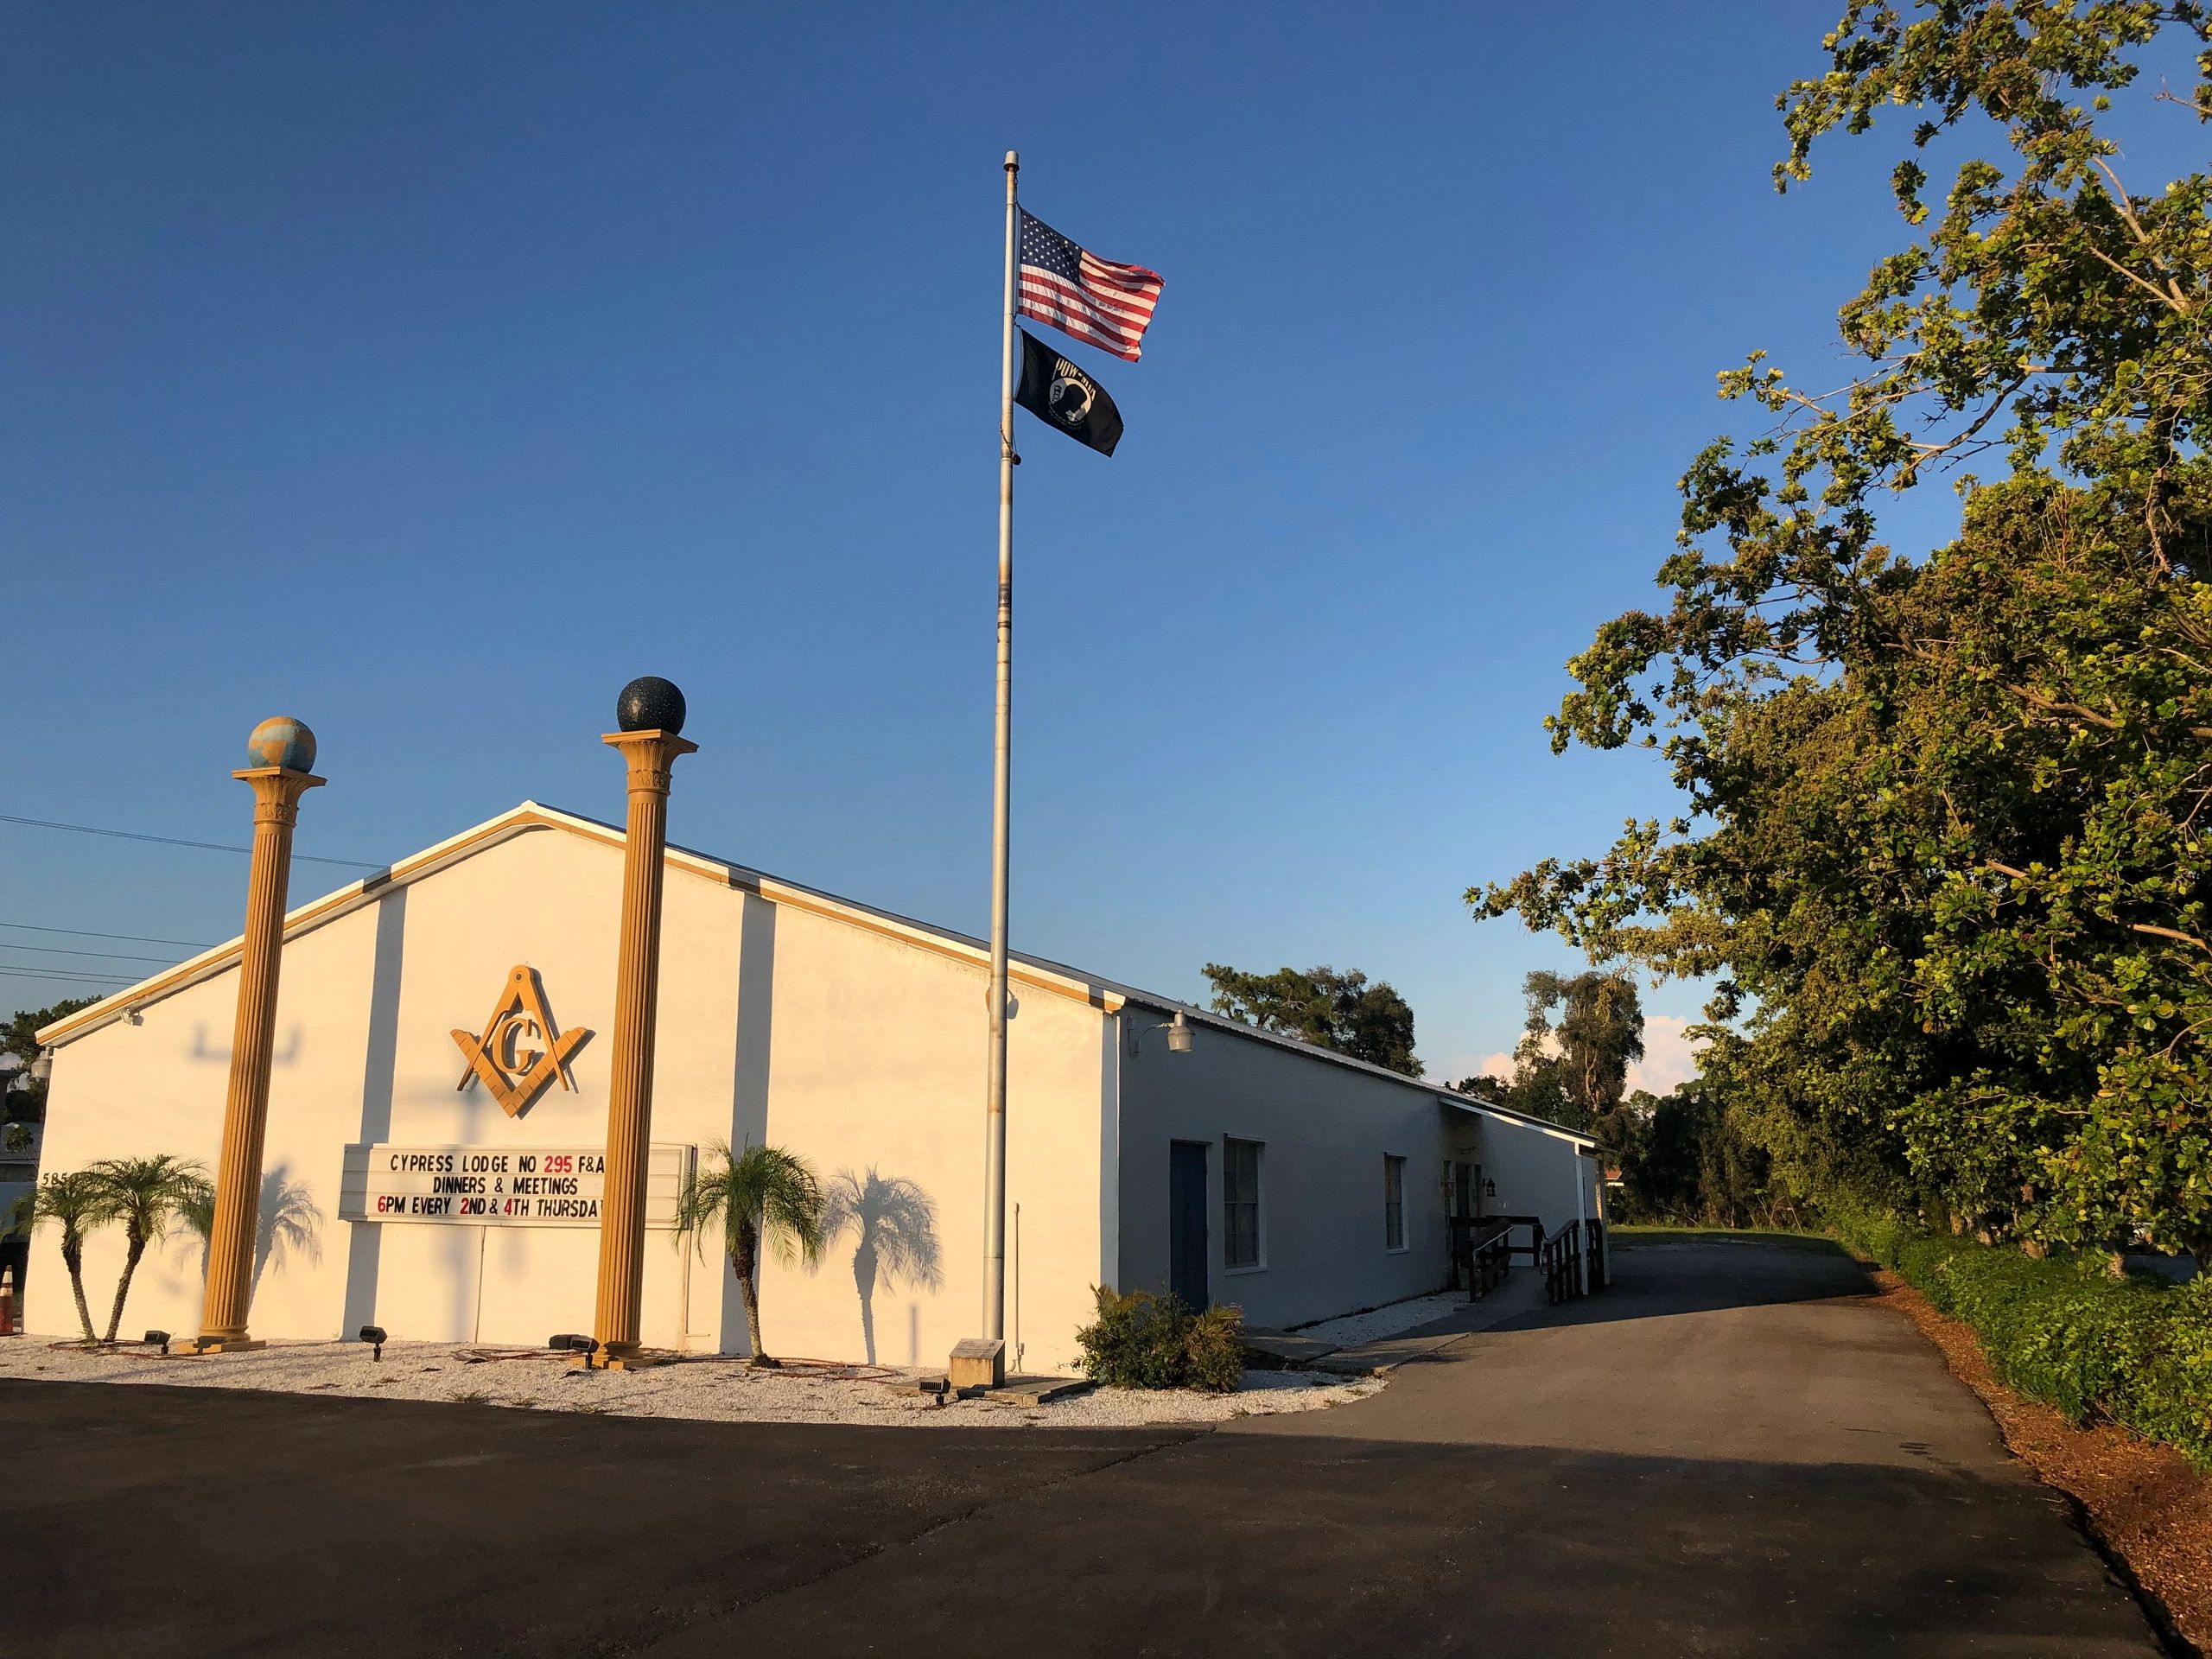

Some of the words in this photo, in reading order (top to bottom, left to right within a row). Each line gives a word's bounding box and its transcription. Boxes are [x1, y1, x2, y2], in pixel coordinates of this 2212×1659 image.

[492, 1017, 536, 1074] G
[391, 1154, 454, 1172] CYPRESS
[462, 1155, 509, 1173] LODGE
[518, 1155, 537, 1173] NO
[544, 1155, 573, 1173] 295
[433, 1177, 486, 1194] DINNERS
[494, 1177, 503, 1193] &
[513, 1177, 578, 1195] MEETINGS
[378, 1196, 406, 1213] 6PM
[412, 1197, 451, 1215] EVERY
[460, 1198, 486, 1215] 2ND
[489, 1198, 498, 1215] &
[504, 1198, 530, 1216] 4TH
[537, 1198, 604, 1217] THURSDA
